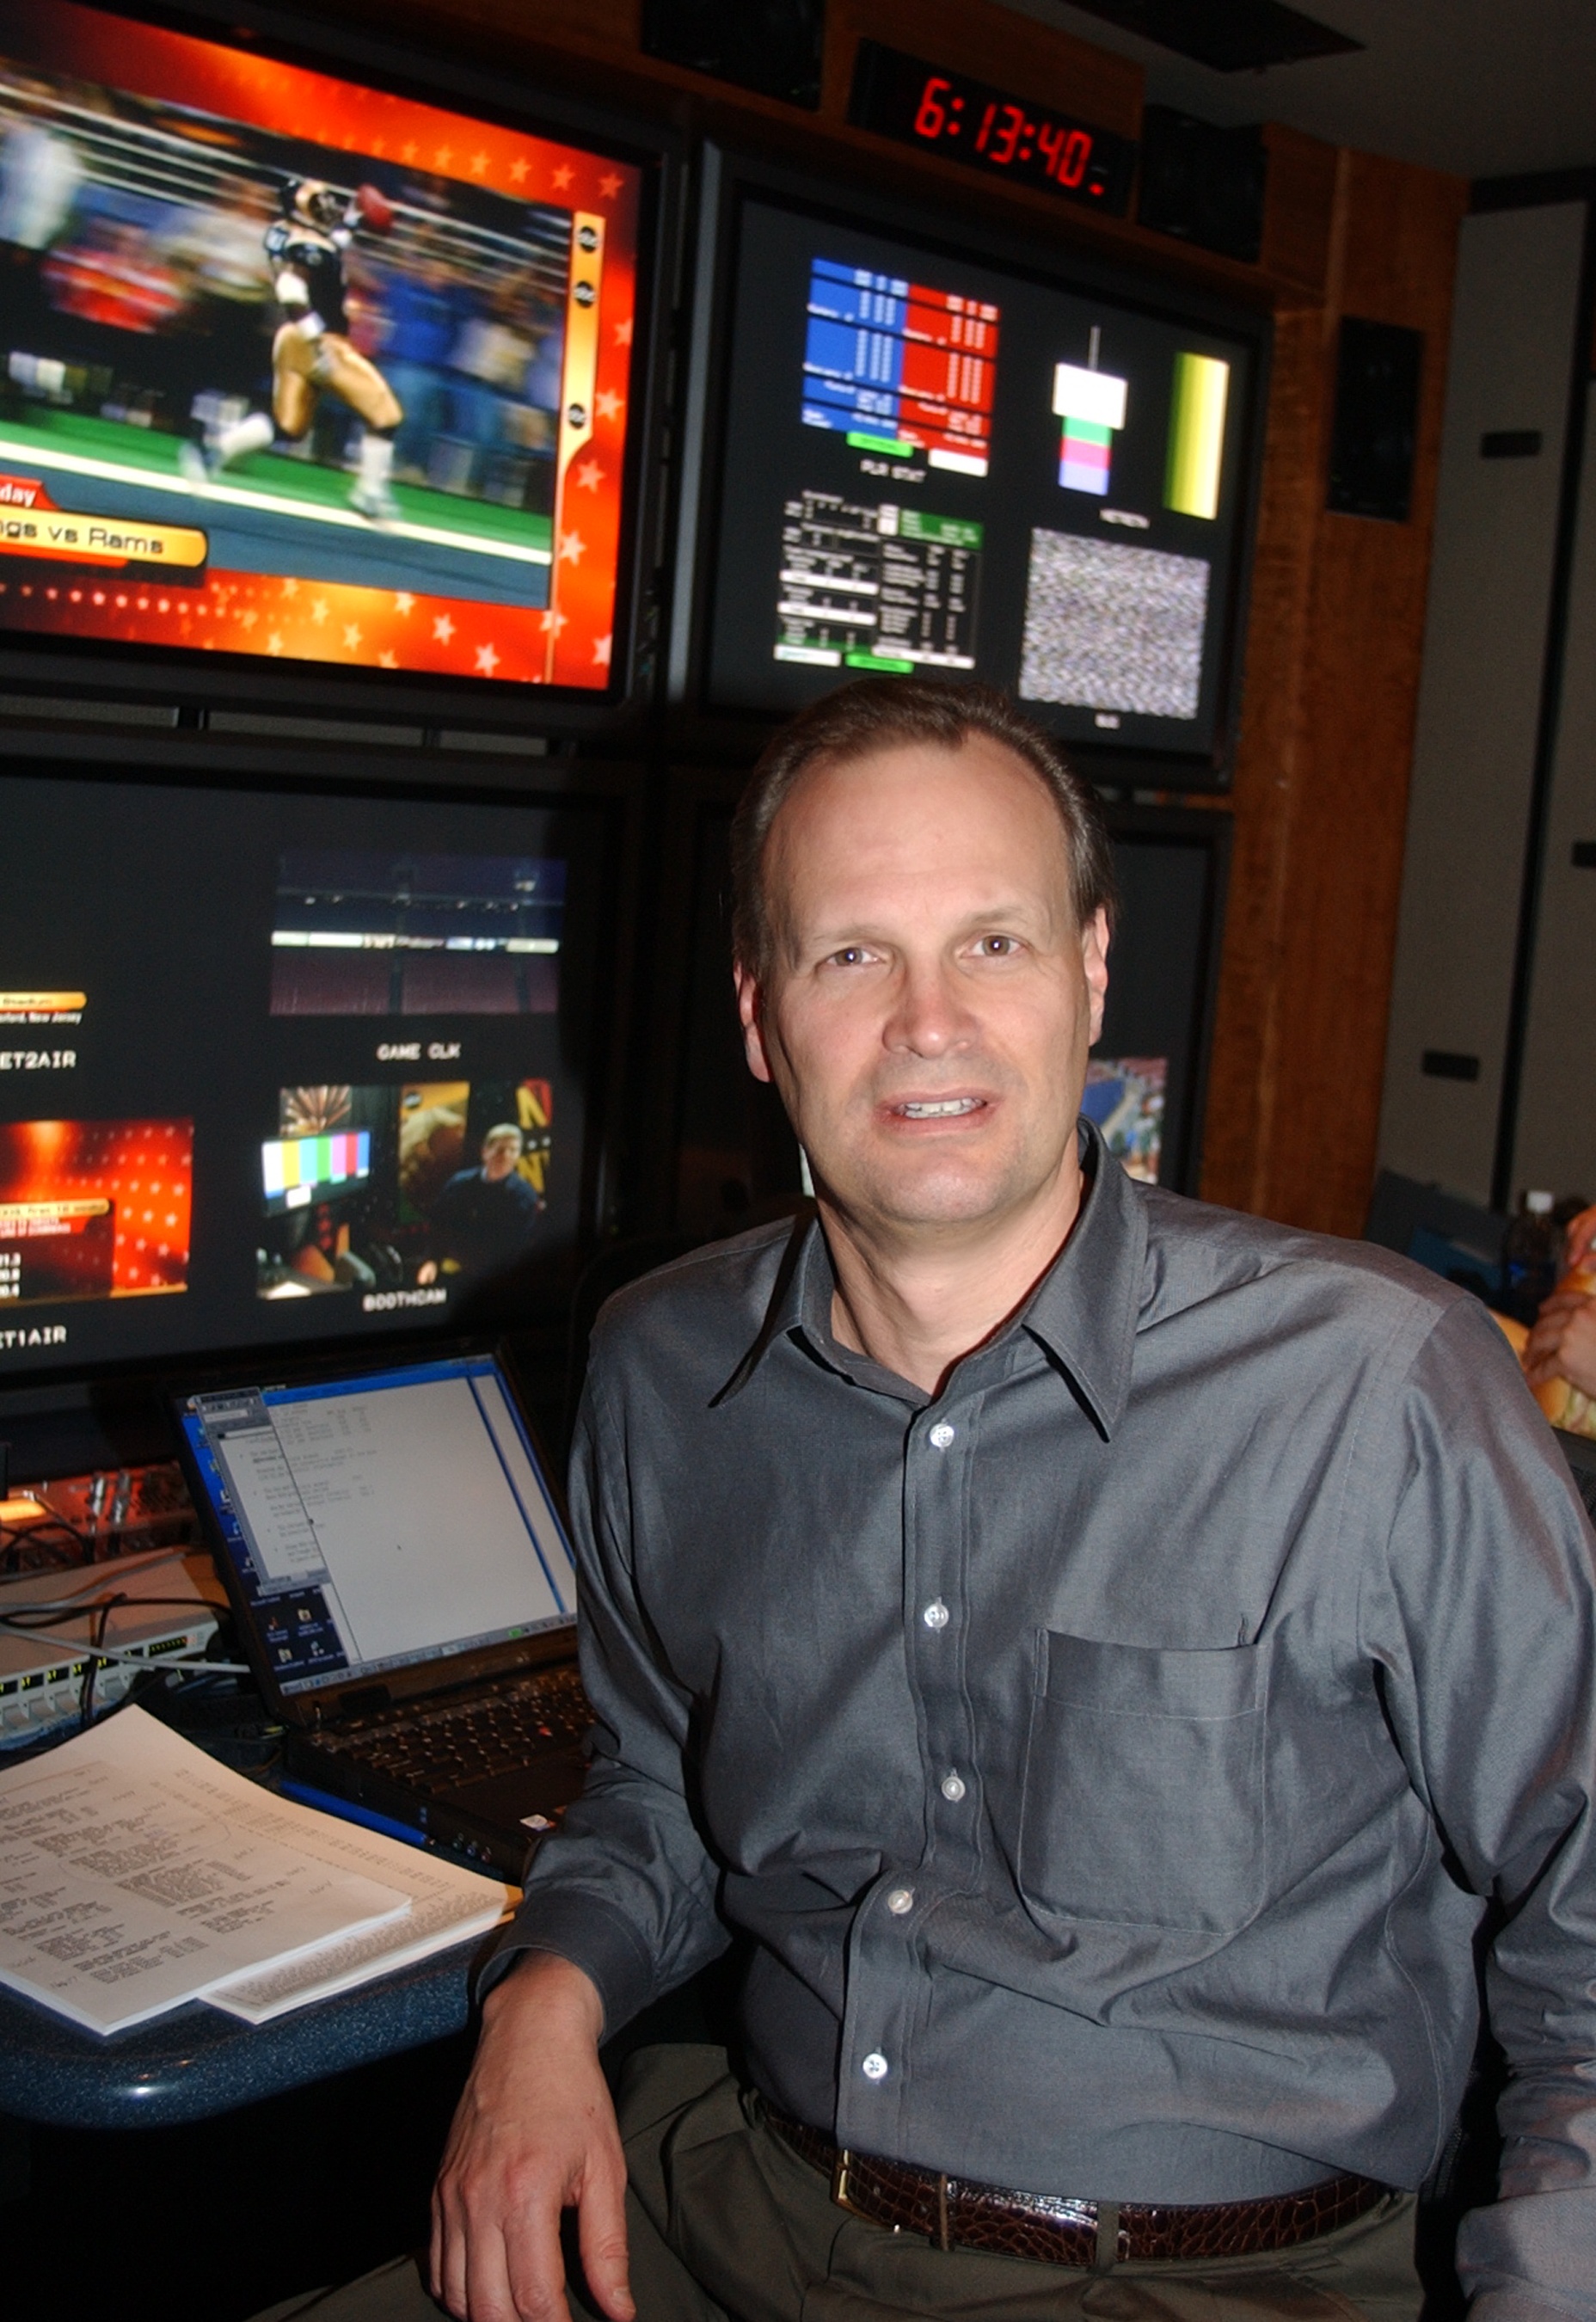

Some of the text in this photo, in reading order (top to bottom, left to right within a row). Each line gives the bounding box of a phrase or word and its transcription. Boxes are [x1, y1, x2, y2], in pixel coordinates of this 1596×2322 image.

[914, 76, 1093, 188] 6:13:40
[0, 519, 164, 554] gs vs Rams
[377, 1042, 462, 1061] GAME CLK
[363, 1288, 448, 1312] BOOTHCAM
